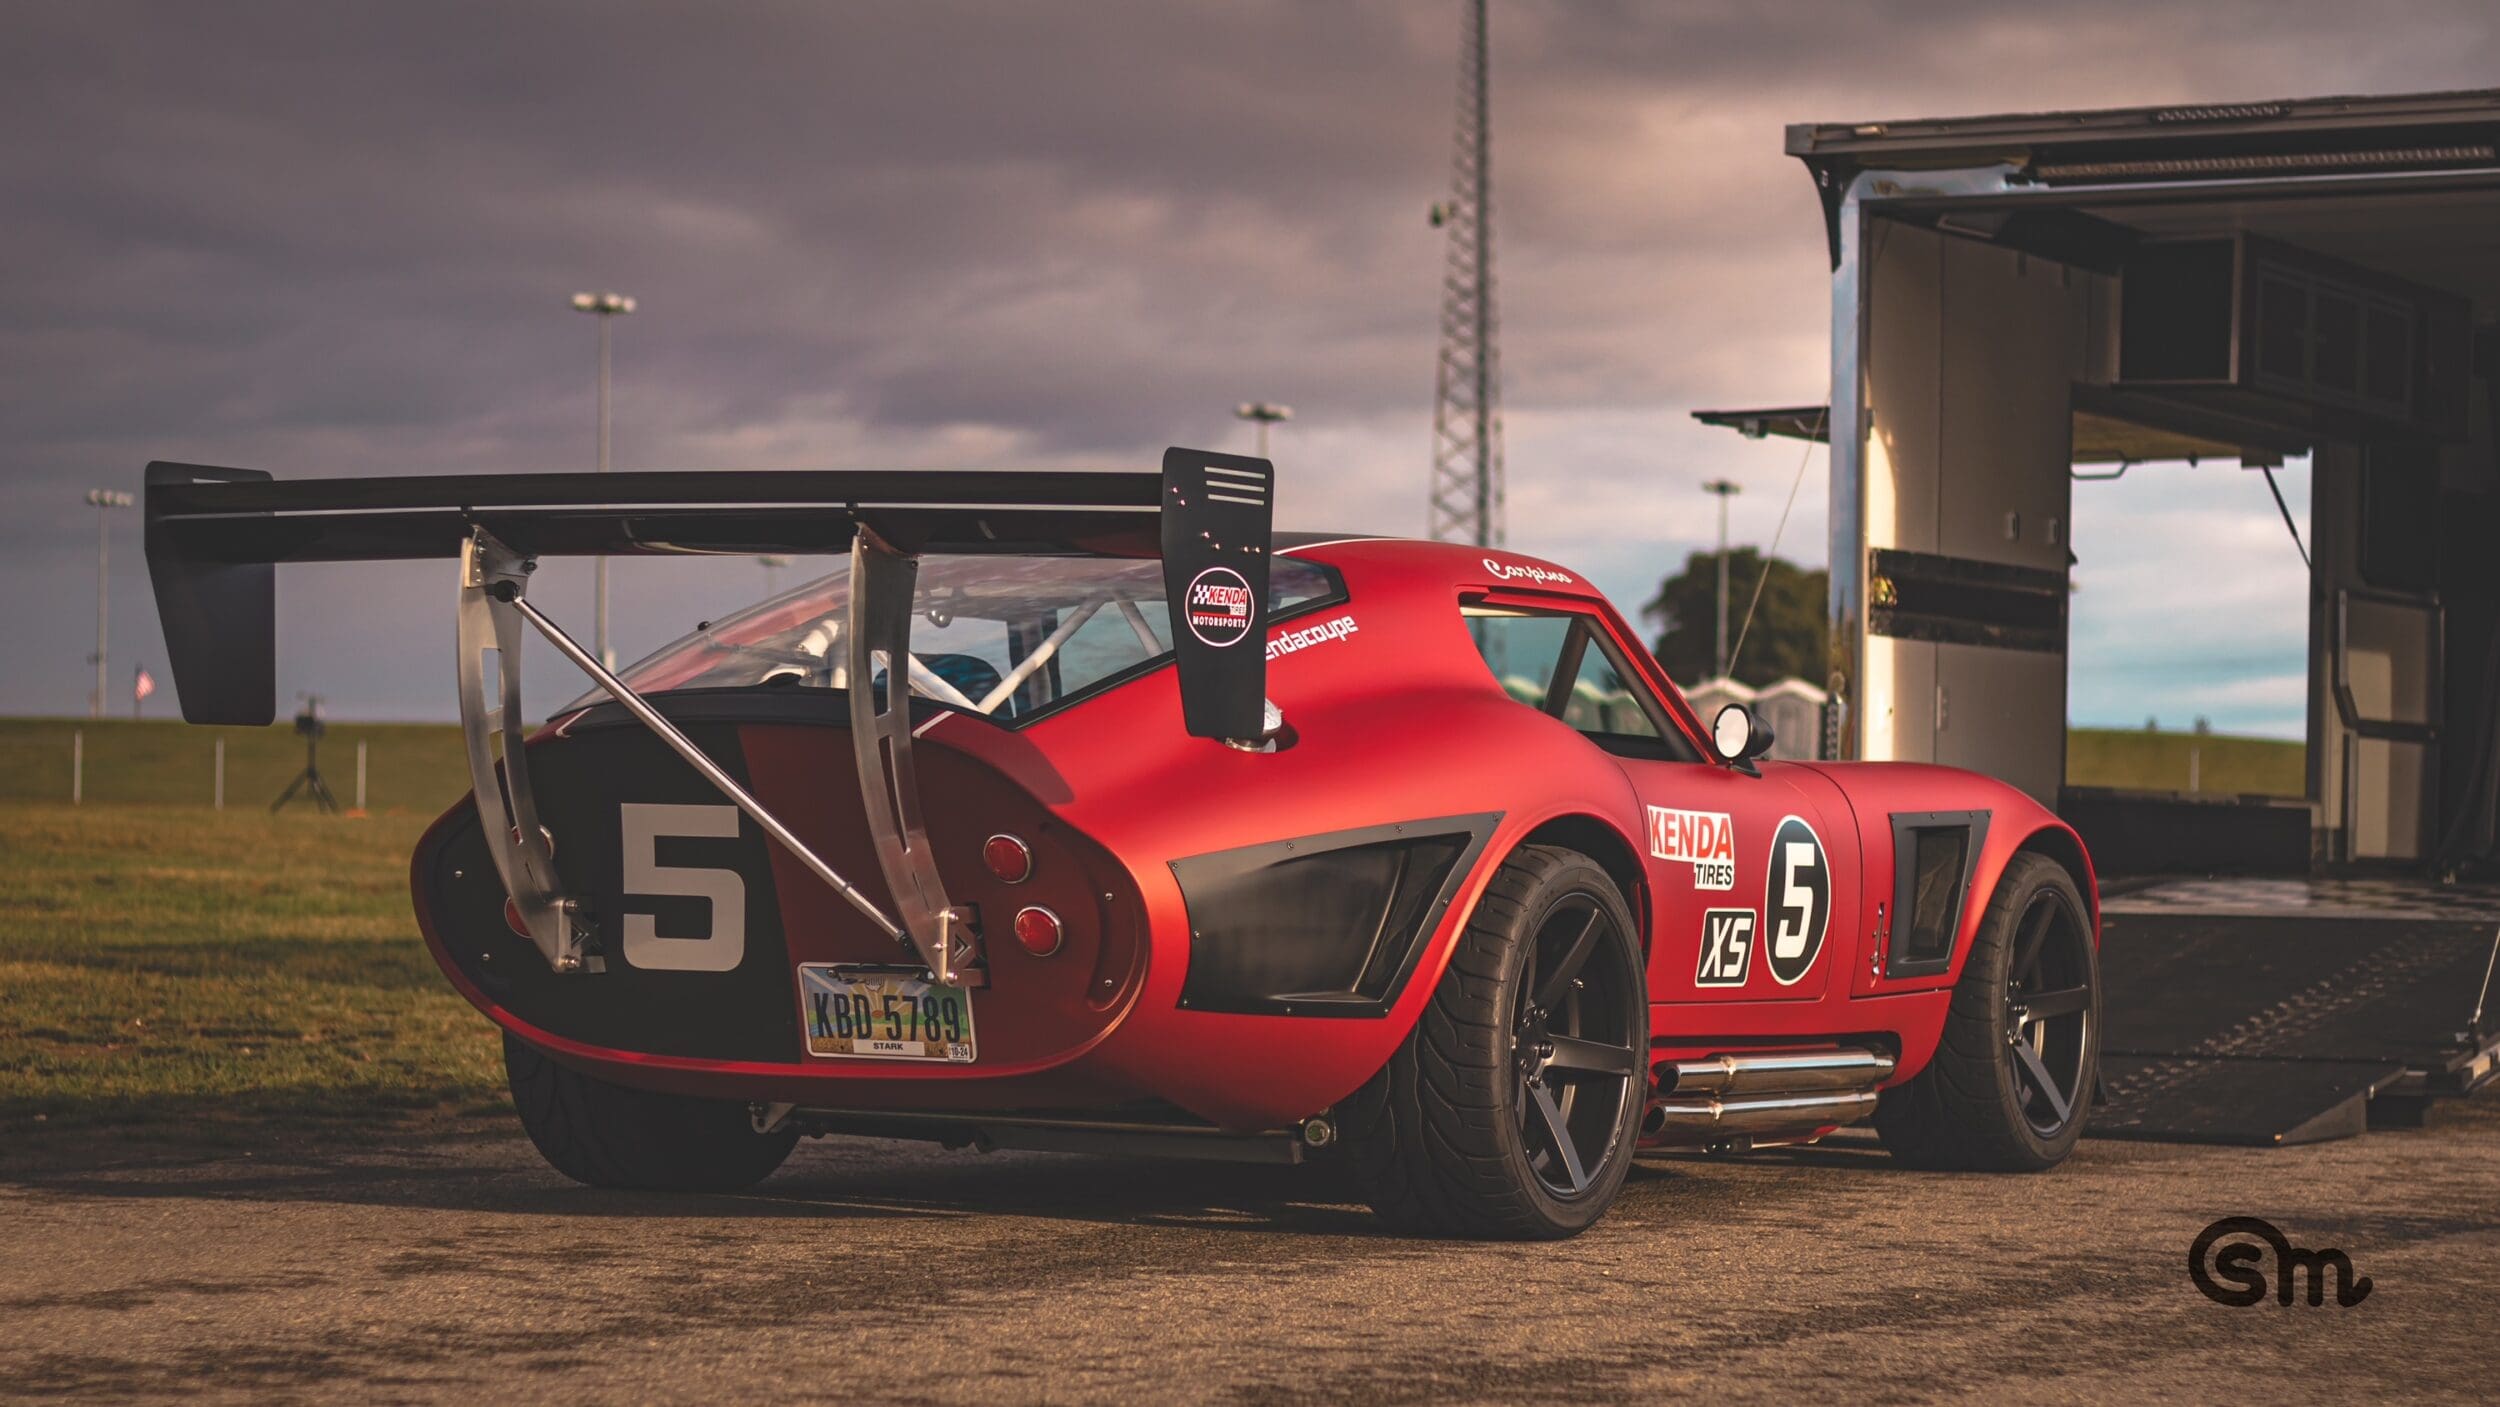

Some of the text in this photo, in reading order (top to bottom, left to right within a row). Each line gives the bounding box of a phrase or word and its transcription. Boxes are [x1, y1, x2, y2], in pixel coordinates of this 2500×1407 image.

[1193, 615, 1246, 628] MOTORSPORTS
[1207, 586, 1247, 606] KENDA
[1649, 808, 1733, 861] KENDA
[620, 802, 745, 972] 5
[1696, 863, 1733, 886] TIRES
[1775, 841, 1815, 959] 5
[1700, 917, 1752, 978] XS
[813, 992, 961, 1043] KBD 5789
[872, 1041, 905, 1051] STARK
